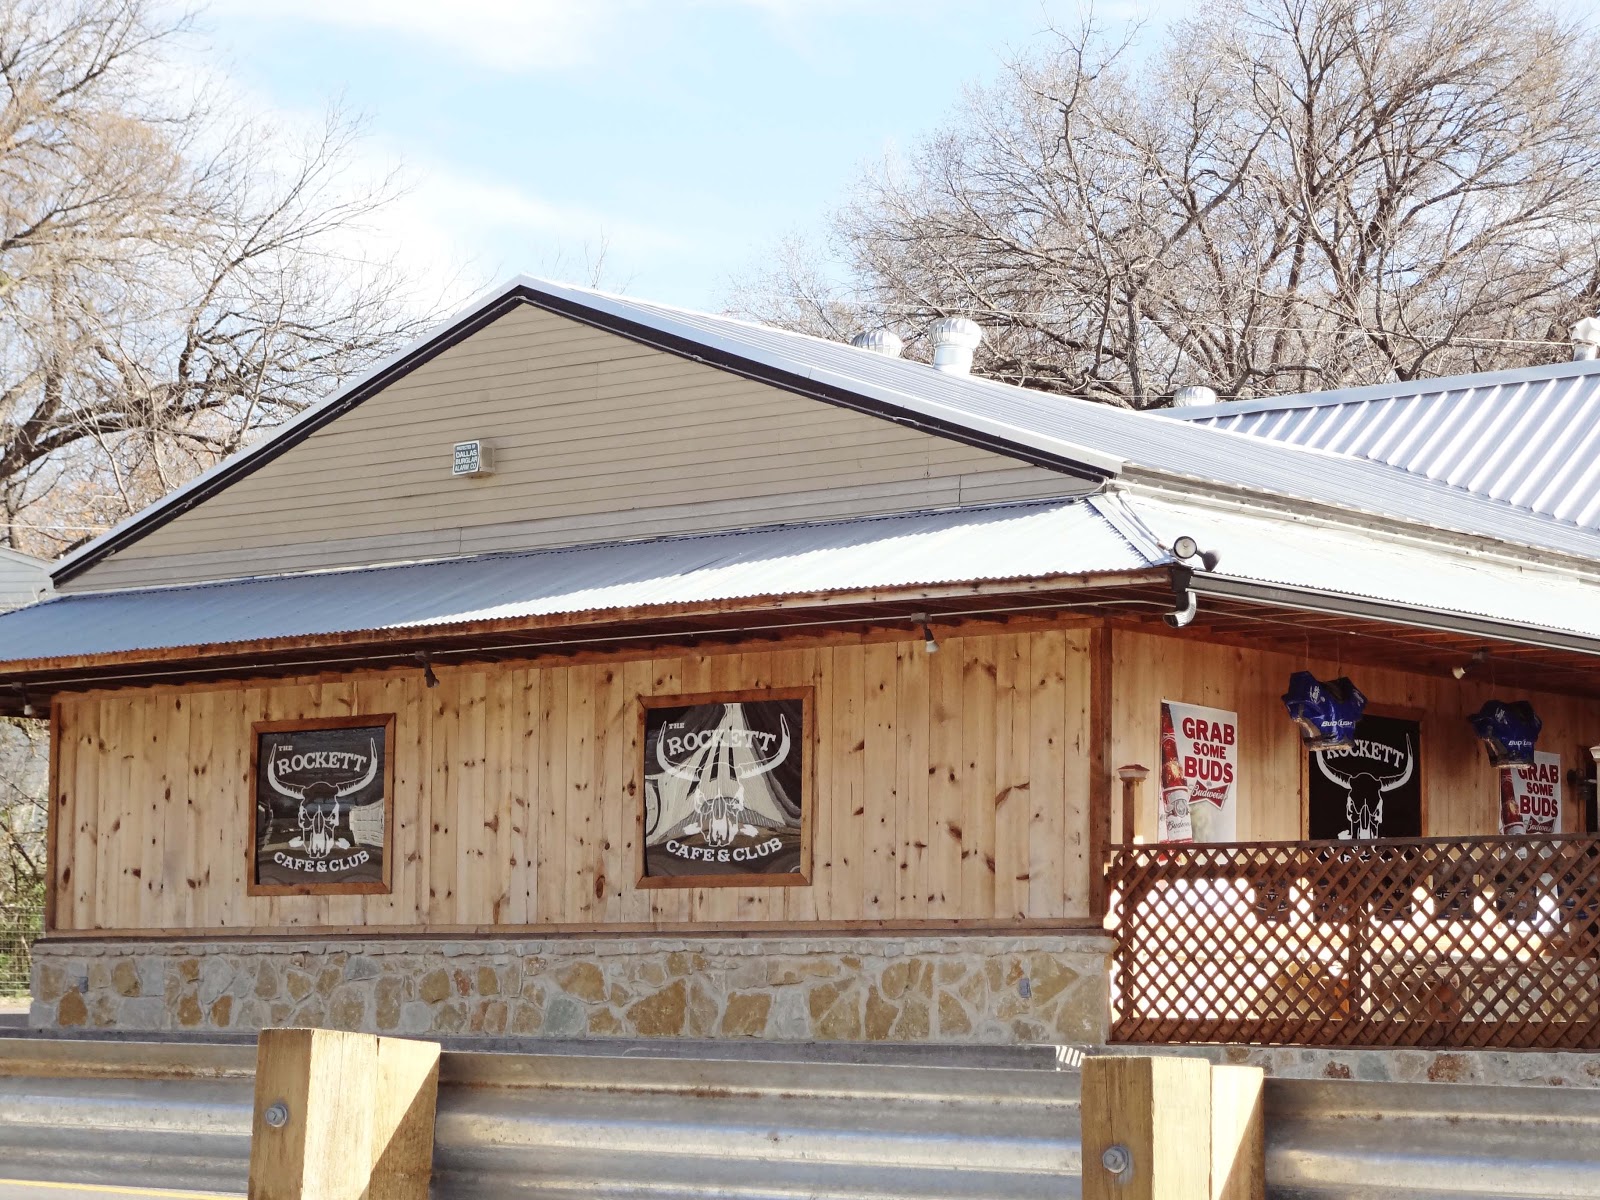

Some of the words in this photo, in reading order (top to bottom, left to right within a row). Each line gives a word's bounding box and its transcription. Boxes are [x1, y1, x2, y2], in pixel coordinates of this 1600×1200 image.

[455, 449, 477, 458] DALLAS
[455, 456, 477, 465] BURGLAR
[668, 722, 685, 730] THE
[1182, 717, 1235, 745] GRAB
[666, 728, 777, 756] ROCKETT
[1193, 742, 1227, 760] SOME
[277, 751, 367, 776] ROCKETT
[1184, 756, 1234, 784] BUDS
[1526, 782, 1554, 797] SOME
[1519, 794, 1559, 818] BUDS
[273, 852, 315, 872] CAFE
[316, 861, 328, 873] &
[329, 850, 370, 872] CLUB
[666, 840, 715, 862] CAFE
[717, 849, 731, 863] &
[732, 837, 783, 861] CLUB
